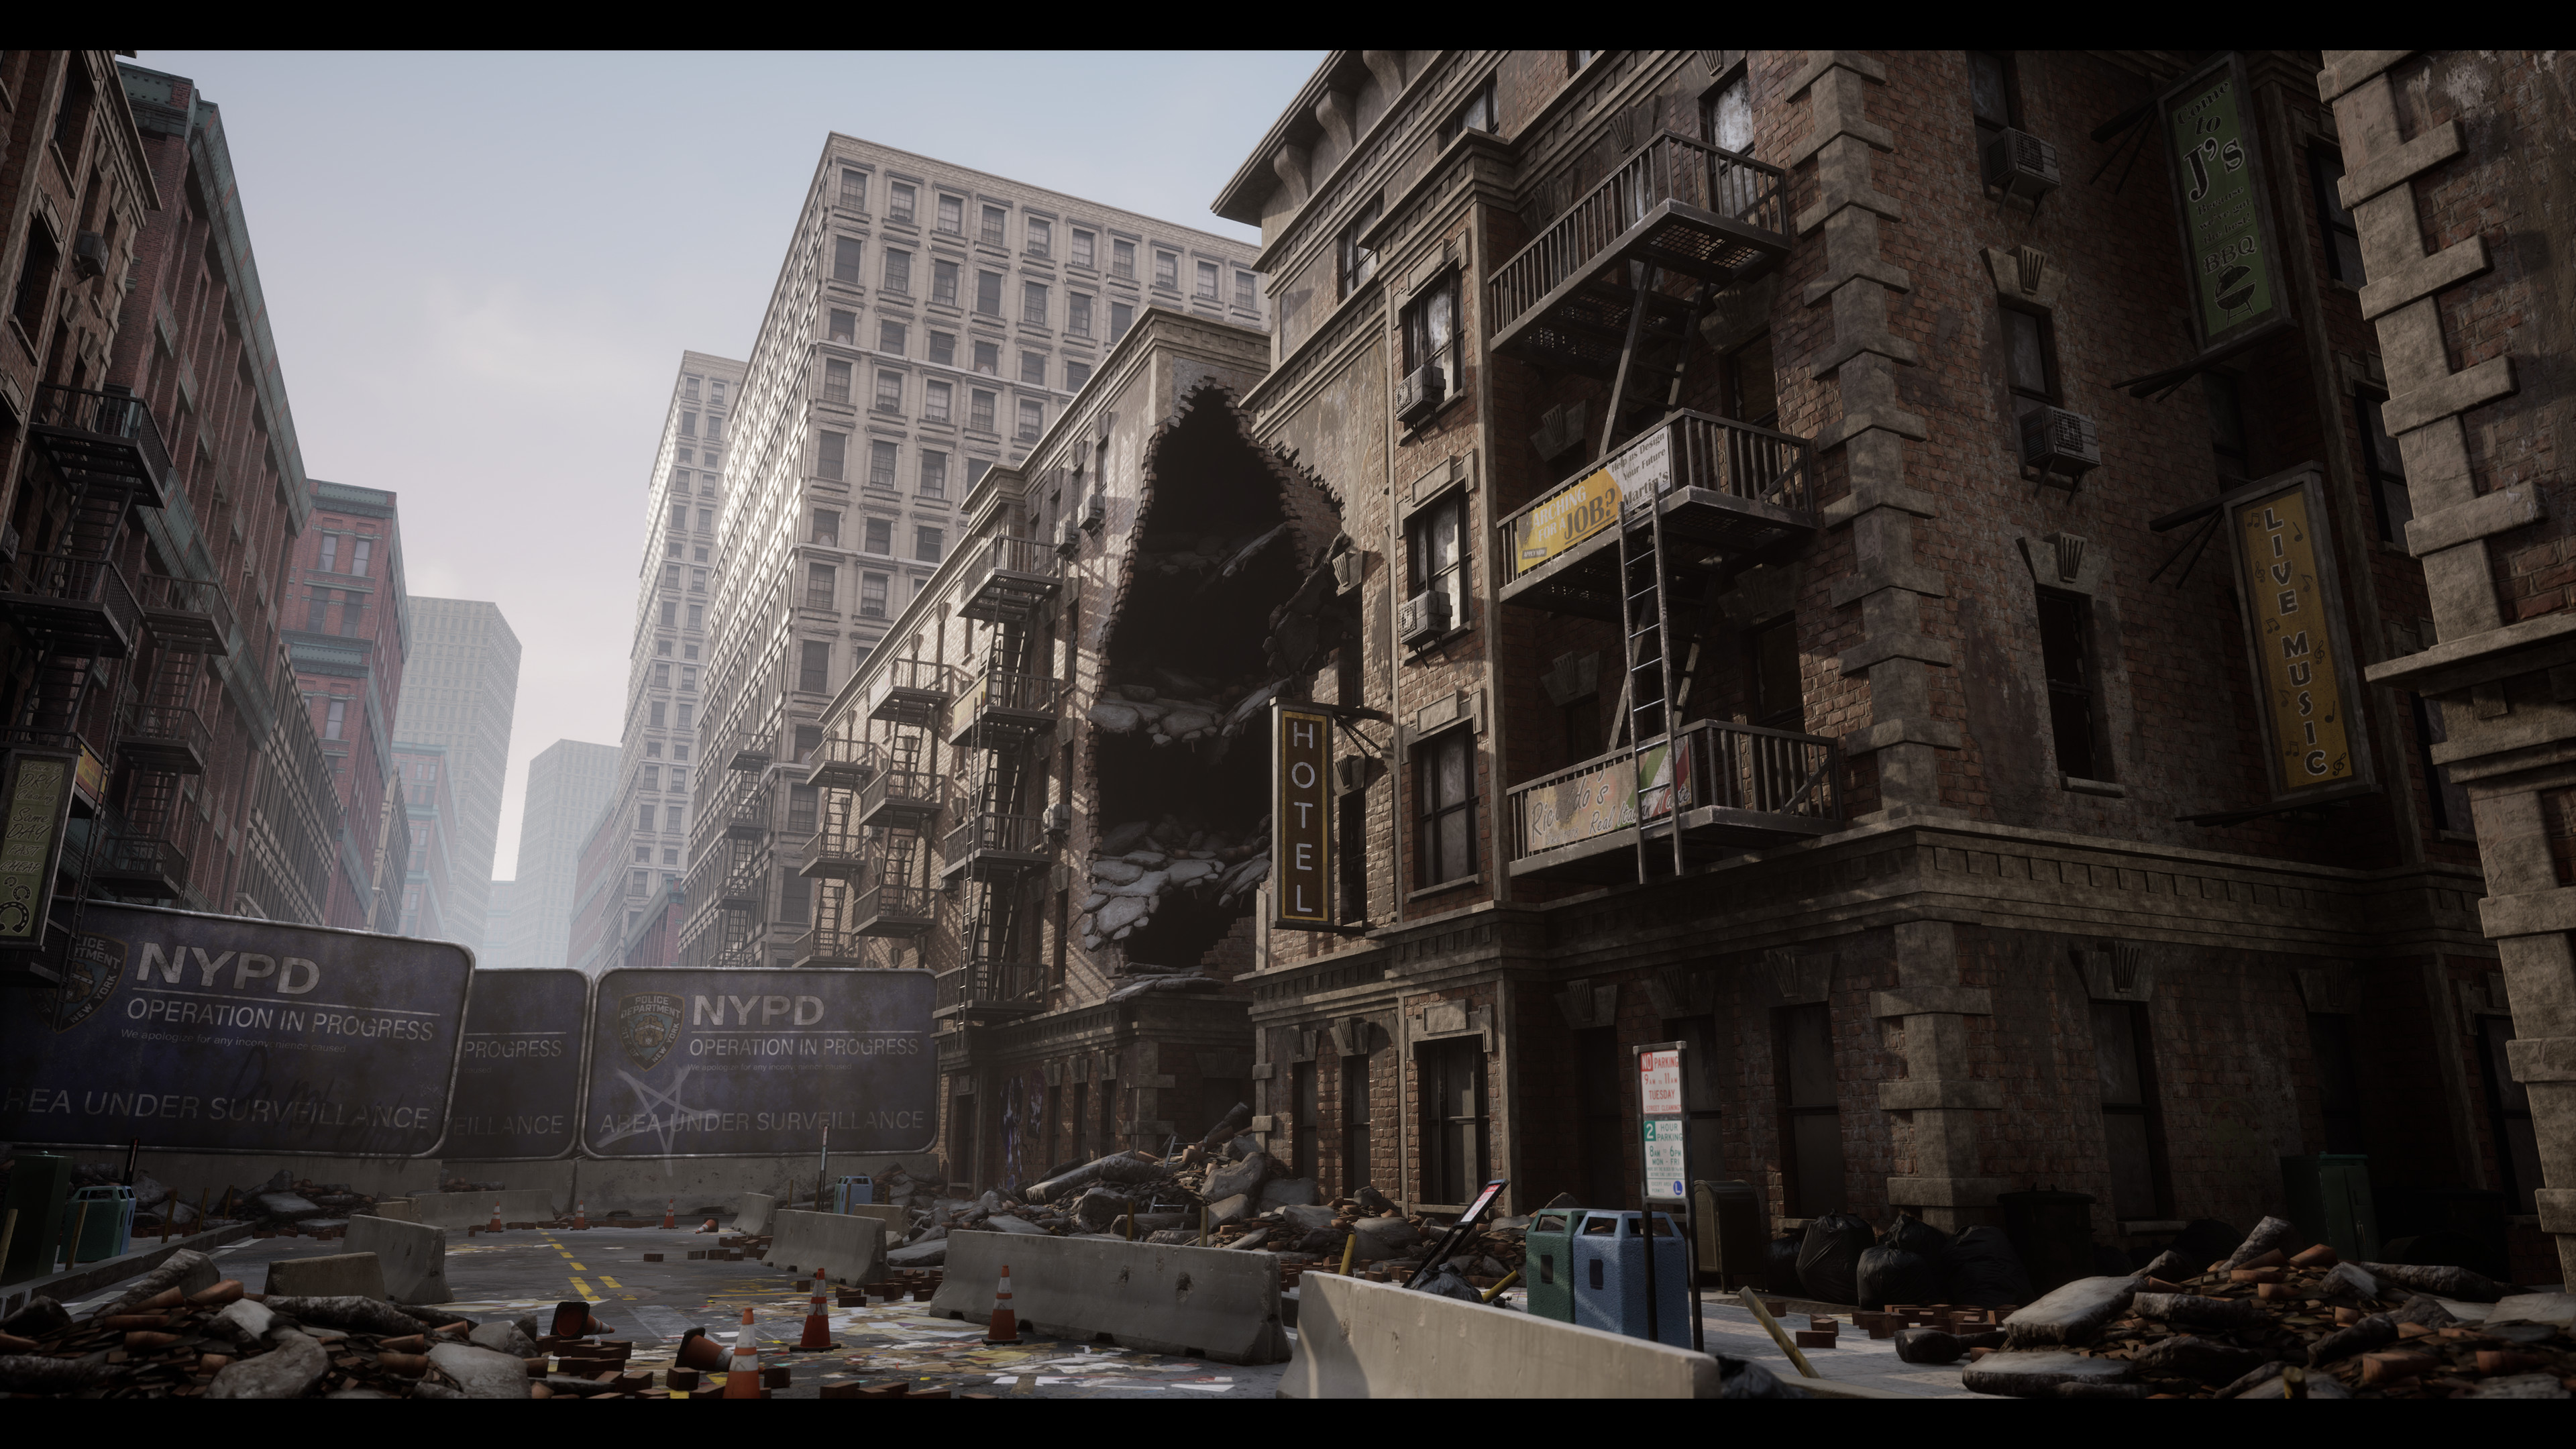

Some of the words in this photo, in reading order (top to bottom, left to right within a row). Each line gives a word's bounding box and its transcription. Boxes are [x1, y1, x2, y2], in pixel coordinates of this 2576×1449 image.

[2177, 80, 2229, 125] Come
[2195, 115, 2222, 136] to
[2183, 137, 2245, 202] J's
[2197, 185, 2245, 217] Because
[2198, 211, 2231, 232] we've
[2233, 197, 2252, 217] got
[2201, 229, 2222, 246] the
[2224, 213, 2252, 237] best!
[2204, 235, 2257, 275] BBQ
[1611, 459, 1627, 474] Help
[1629, 451, 1638, 464] us
[1640, 433, 1665, 454] Design
[1623, 466, 1640, 481] Your
[1642, 448, 1666, 470] Future
[1623, 471, 1669, 506] Martin's
[1531, 486, 1587, 530] ARCHING
[1539, 523, 1558, 542] FOR
[1559, 521, 1566, 533] A
[1564, 488, 1616, 540] JOB?
[2263, 507, 2300, 616] LIVE
[2281, 630, 2328, 776] MUSIC
[17, 773, 60, 790] DRY
[16, 790, 56, 804] Cleaning
[1532, 769, 1609, 843] Ricdo's
[1589, 805, 1615, 836] Real
[1618, 801, 1650, 827] Italan
[1658, 784, 1690, 814] Tate
[12, 807, 50, 823] Same
[1291, 721, 1316, 913] HOTEL
[6, 824, 52, 841] DAY
[7, 845, 44, 857] FAST
[1, 861, 42, 873] CHEAP
[76, 936, 107, 951] LICE
[74, 947, 121, 970] RTMENT
[136, 942, 321, 994] NYPD
[69, 1003, 93, 1023] NEW
[94, 975, 117, 1000] YORK
[621, 1004, 682, 1019] DEPARTMENT
[635, 996, 669, 1006] POLICE
[691, 995, 825, 1026] NYPD
[127, 998, 273, 1030] OPERATION
[280, 1010, 304, 1032] IN
[312, 1012, 434, 1042] PROGRESS
[121, 1028, 139, 1039] We
[142, 1030, 193, 1044] apologize
[197, 1034, 211, 1044] for
[214, 1036, 233, 1046] any
[235, 1037, 309, 1051] inconvenience
[311, 1042, 346, 1053] caused
[463, 1040, 562, 1058] PROGRESS
[629, 1049, 639, 1057] OF
[651, 1046, 667, 1063] NEW
[666, 1022, 680, 1043] YORK
[689, 1038, 794, 1057] OPERATION
[799, 1038, 818, 1056] IN
[823, 1037, 919, 1057] PROGRESS
[688, 1063, 700, 1071] We
[702, 1063, 738, 1072] apologize
[753, 1064, 767, 1072] any
[1642, 1054, 1652, 1070] NO
[1654, 1056, 1679, 1068] PARKING
[1648, 1089, 1675, 1100] TUESDAY
[84, 1091, 200, 1120] UNDER
[208, 1097, 431, 1130] SURVEILLANCE
[600, 1114, 661, 1133] AREA
[671, 1112, 749, 1132] UNDER
[756, 1110, 924, 1131] SURVEILLANCE
[1646, 1123, 1654, 1139] 2
[1657, 1133, 1682, 1141] PARKING
[1660, 1123, 1678, 1131] HOUR
